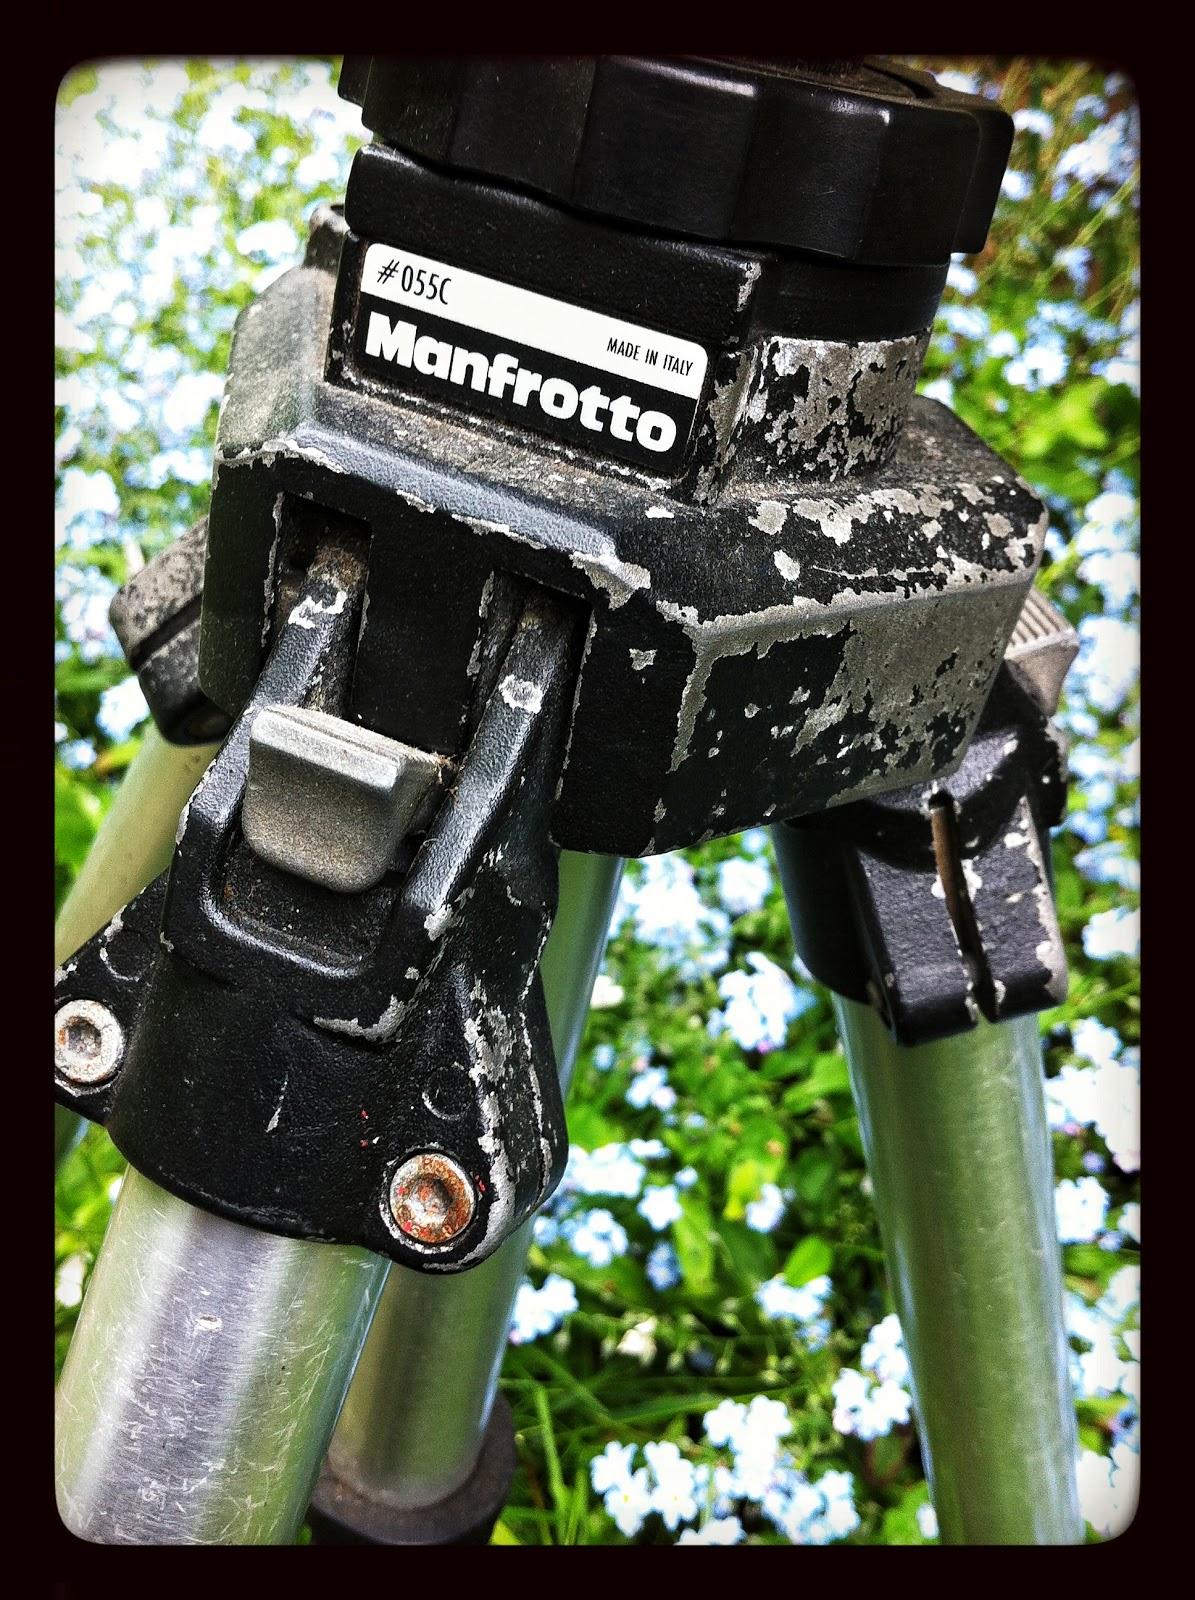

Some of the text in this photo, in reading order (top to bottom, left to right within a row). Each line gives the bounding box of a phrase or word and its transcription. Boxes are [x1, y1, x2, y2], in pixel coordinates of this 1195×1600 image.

[377, 259, 452, 305] #055C
[606, 337, 694, 377] MADE IN ITALY
[365, 311, 677, 453] Manfrotto
